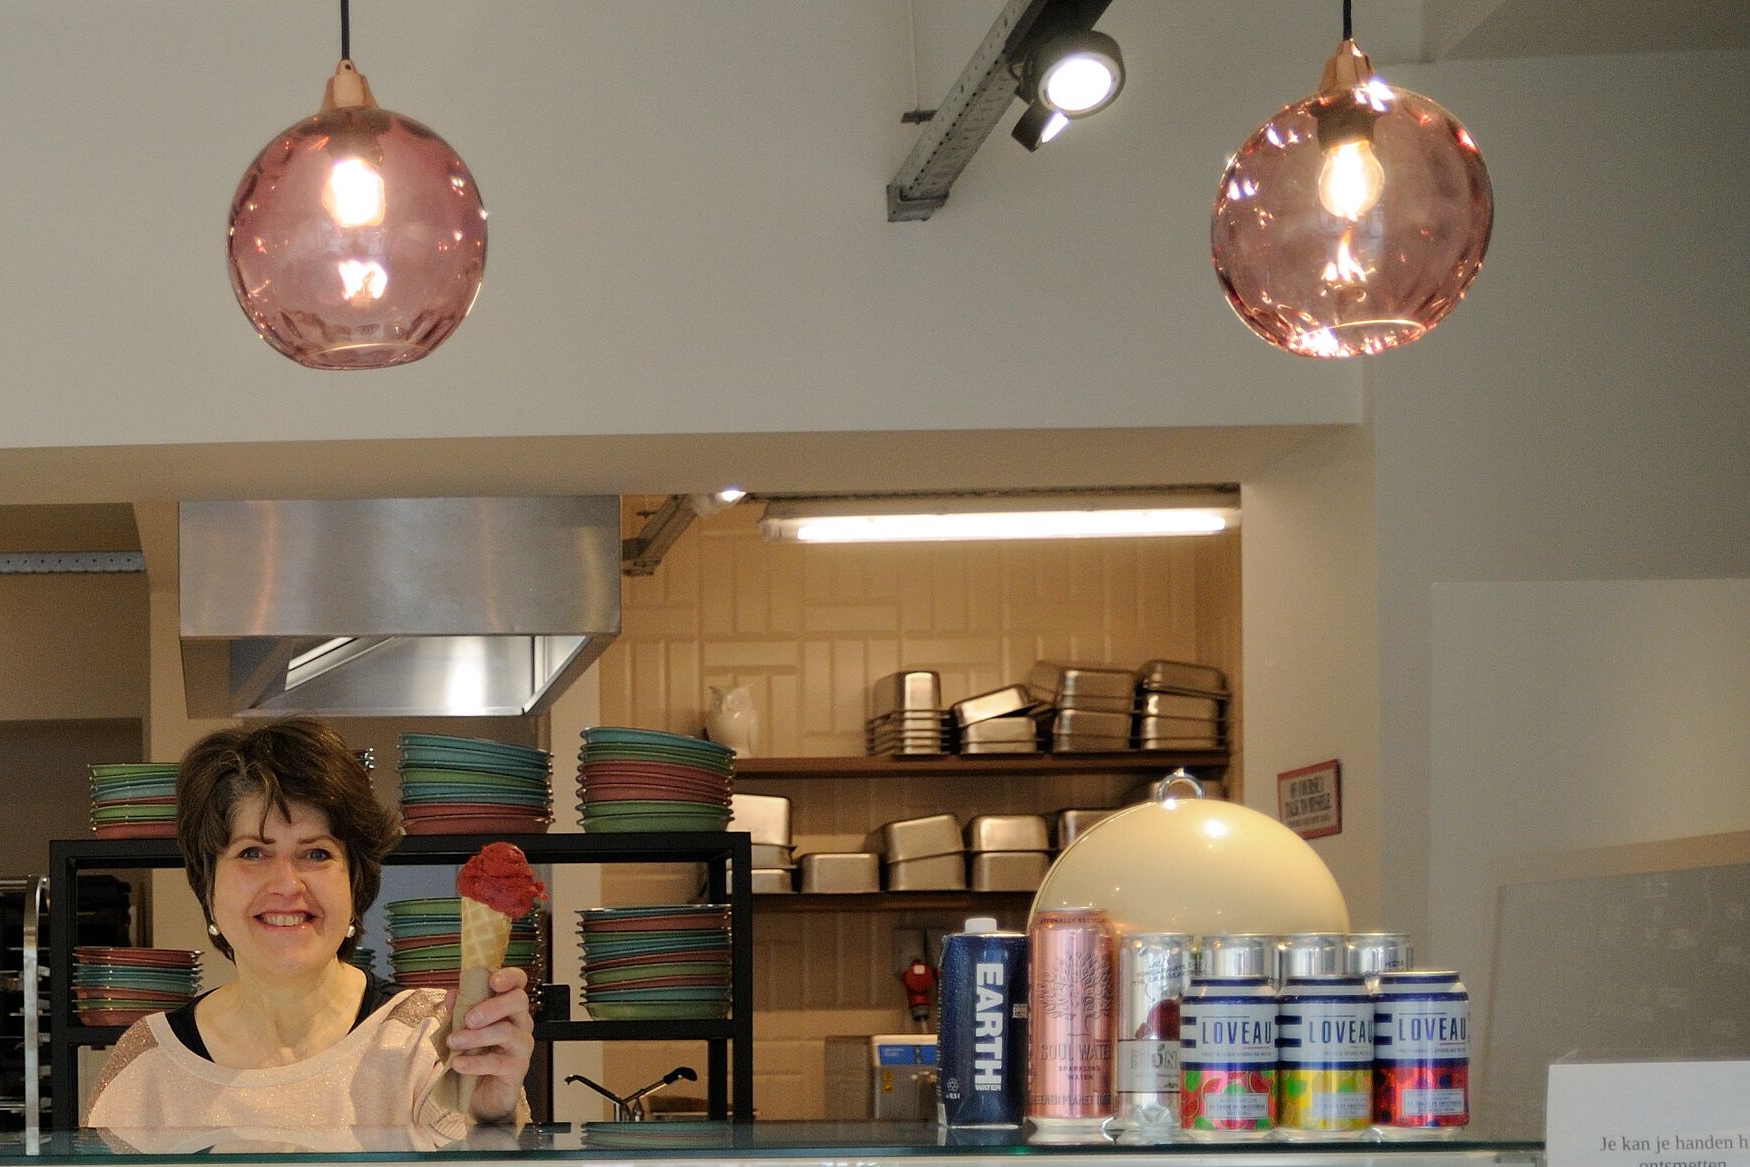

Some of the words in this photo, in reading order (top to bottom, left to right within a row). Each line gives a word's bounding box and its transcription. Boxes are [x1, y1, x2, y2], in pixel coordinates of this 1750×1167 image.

[975, 963, 1003, 1085] EARTH
[1202, 1021, 1272, 1044] LOVEAU
[1309, 1020, 1373, 1044] LOVEAU
[1398, 1017, 1466, 1041] LOVEAU
[1600, 1136, 1617, 1151] Je
[1621, 1136, 1650, 1151] kan
[1655, 1136, 1670, 1154] je
[1675, 1134, 1733, 1150] handen
[1738, 1134, 1750, 1149] h
